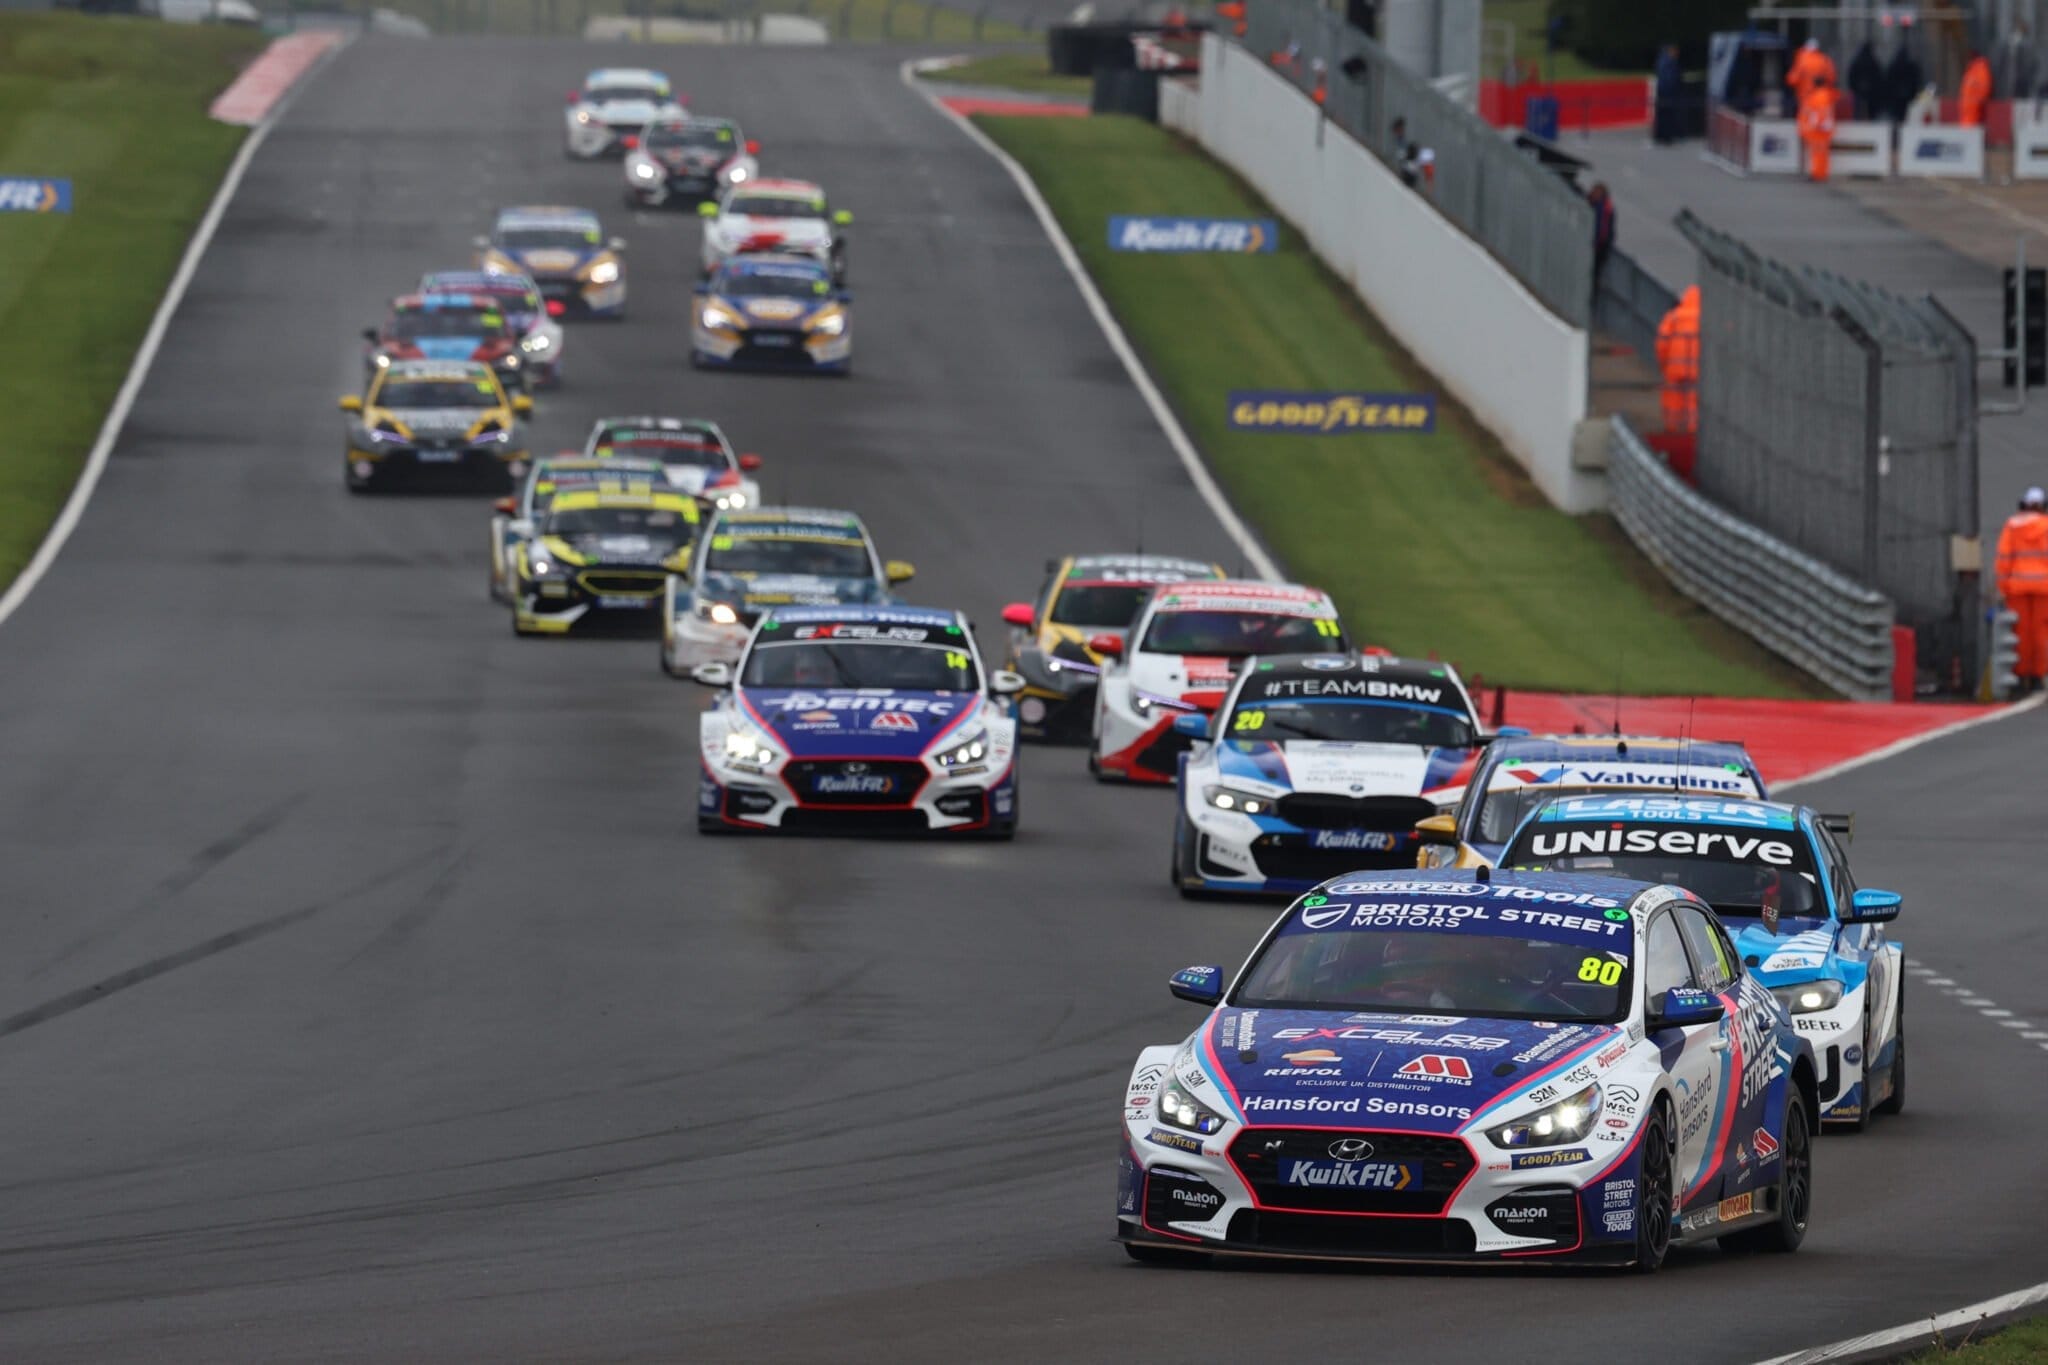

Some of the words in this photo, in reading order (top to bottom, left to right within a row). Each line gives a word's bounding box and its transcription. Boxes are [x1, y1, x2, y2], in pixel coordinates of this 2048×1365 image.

[1233, 396, 1429, 431] GOODYEAR
[1312, 618, 1341, 637] 11
[945, 651, 968, 670] 14
[1264, 680, 1442, 703] #TEAMBMW
[1233, 711, 1265, 730] 20
[1580, 771, 1741, 789] Valvoline
[1566, 799, 1768, 820] LASER
[1630, 809, 1702, 821] TOOLS
[1345, 882, 1473, 894] DRAPER
[1492, 885, 1620, 908] Tools
[1350, 915, 1462, 928] MOTORS
[1355, 903, 1490, 919] BRISTOL
[1498, 909, 1625, 936] STREET
[1577, 956, 1623, 986] 80
[1797, 1019, 1842, 1031] BEER
[1264, 1067, 1343, 1077] REPSOL
[1392, 1072, 1443, 1083] MILLERS
[1445, 1078, 1473, 1087] OILS
[1131, 1083, 1158, 1091] WSC
[1295, 1079, 1346, 1087] EXCLUSIVE
[1367, 1081, 1431, 1092] DISTRIBUTOR
[1529, 1085, 1560, 1104] S2M
[1243, 1096, 1360, 1114] Hansford
[1366, 1097, 1472, 1120] Sensors
[1606, 1101, 1636, 1115] WSC
[1152, 1133, 1197, 1150] GOODYEAR
[1520, 1150, 1584, 1166] GOODYEAR
[1604, 1180, 1635, 1191] BRISTOL
[1604, 1190, 1633, 1201] STREET
[1604, 1200, 1630, 1209] MOTORS
[1606, 1213, 1632, 1222] DRAPER
[1607, 1222, 1632, 1233] Tools
